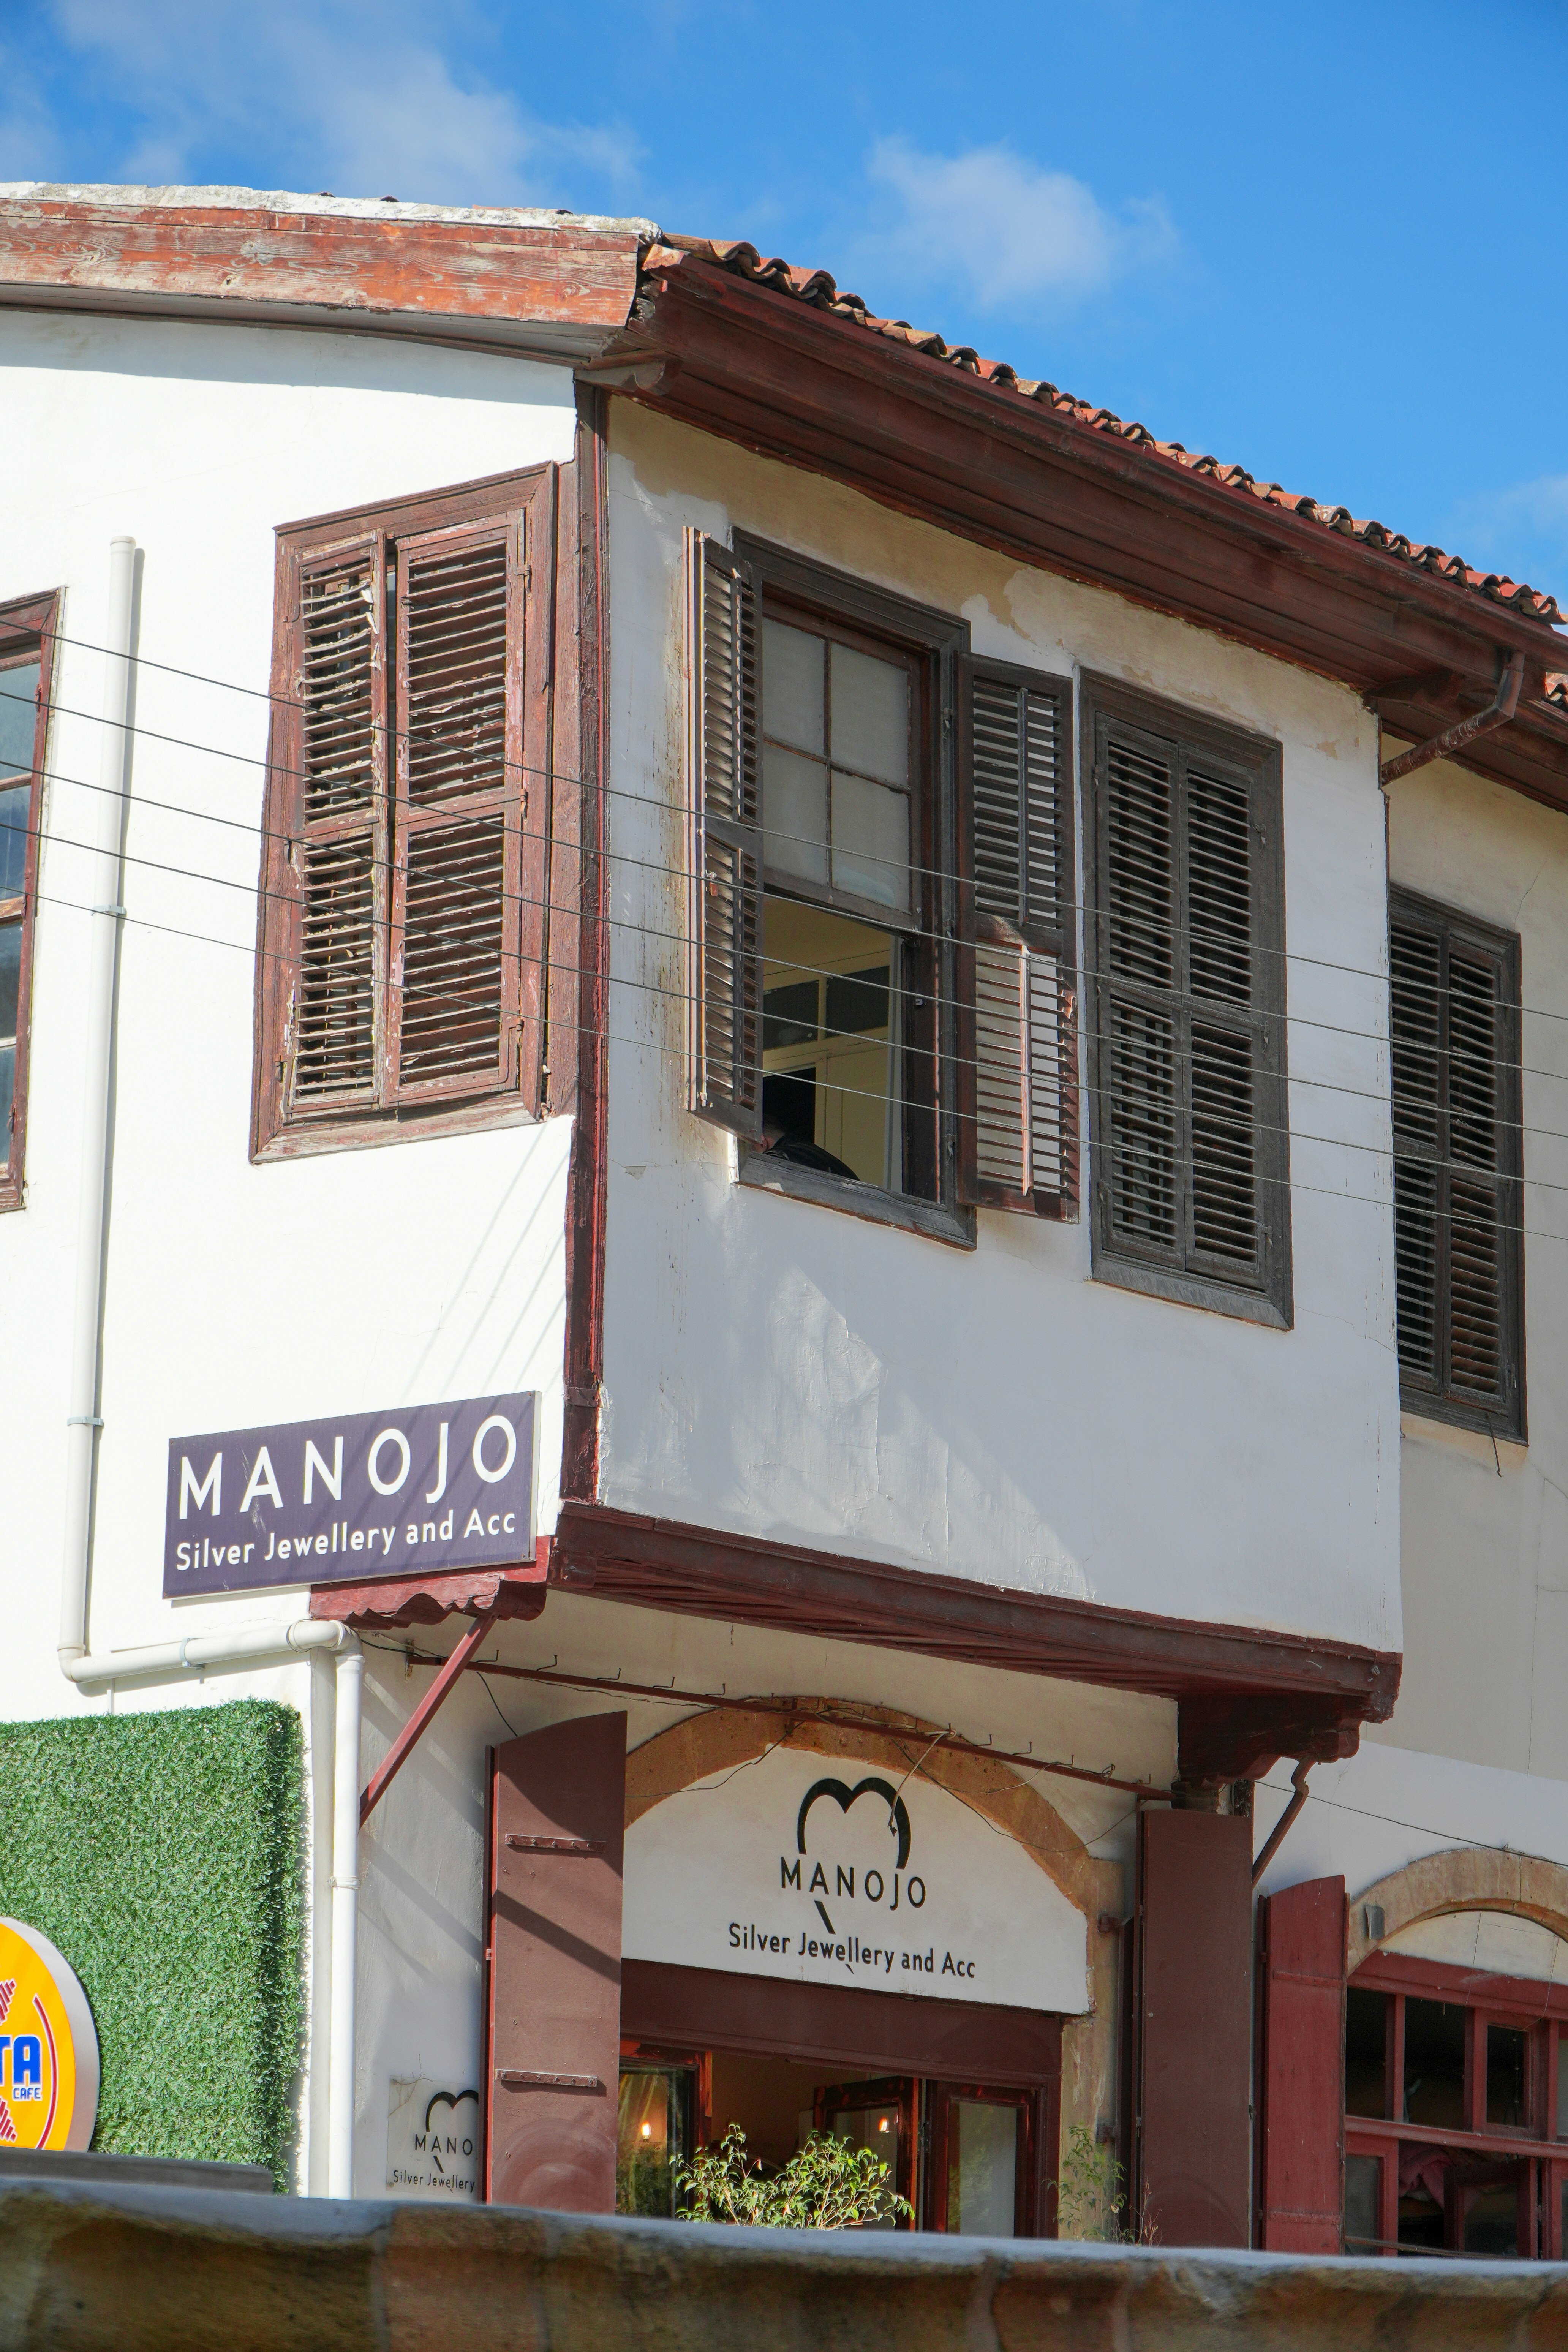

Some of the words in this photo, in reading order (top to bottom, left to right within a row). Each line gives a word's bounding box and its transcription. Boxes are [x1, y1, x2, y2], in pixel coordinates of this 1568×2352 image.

[179, 1415, 517, 1520] MANOJO
[176, 1538, 255, 1571] Silver
[264, 1522, 396, 1561] Jewellery
[406, 1509, 454, 1544] and
[463, 1508, 515, 1538] Acc
[781, 1856, 926, 1911] MANOJO
[729, 1922, 791, 1954] Silver
[798, 1932, 895, 1974] Jewellery
[901, 1948, 934, 1973] and
[941, 1952, 975, 1978] Acc
[13, 2088, 41, 2099] CAFE
[415, 2134, 477, 2160] MANO
[393, 2170, 424, 2185] Silver
[427, 2173, 475, 2193] Jewellery
